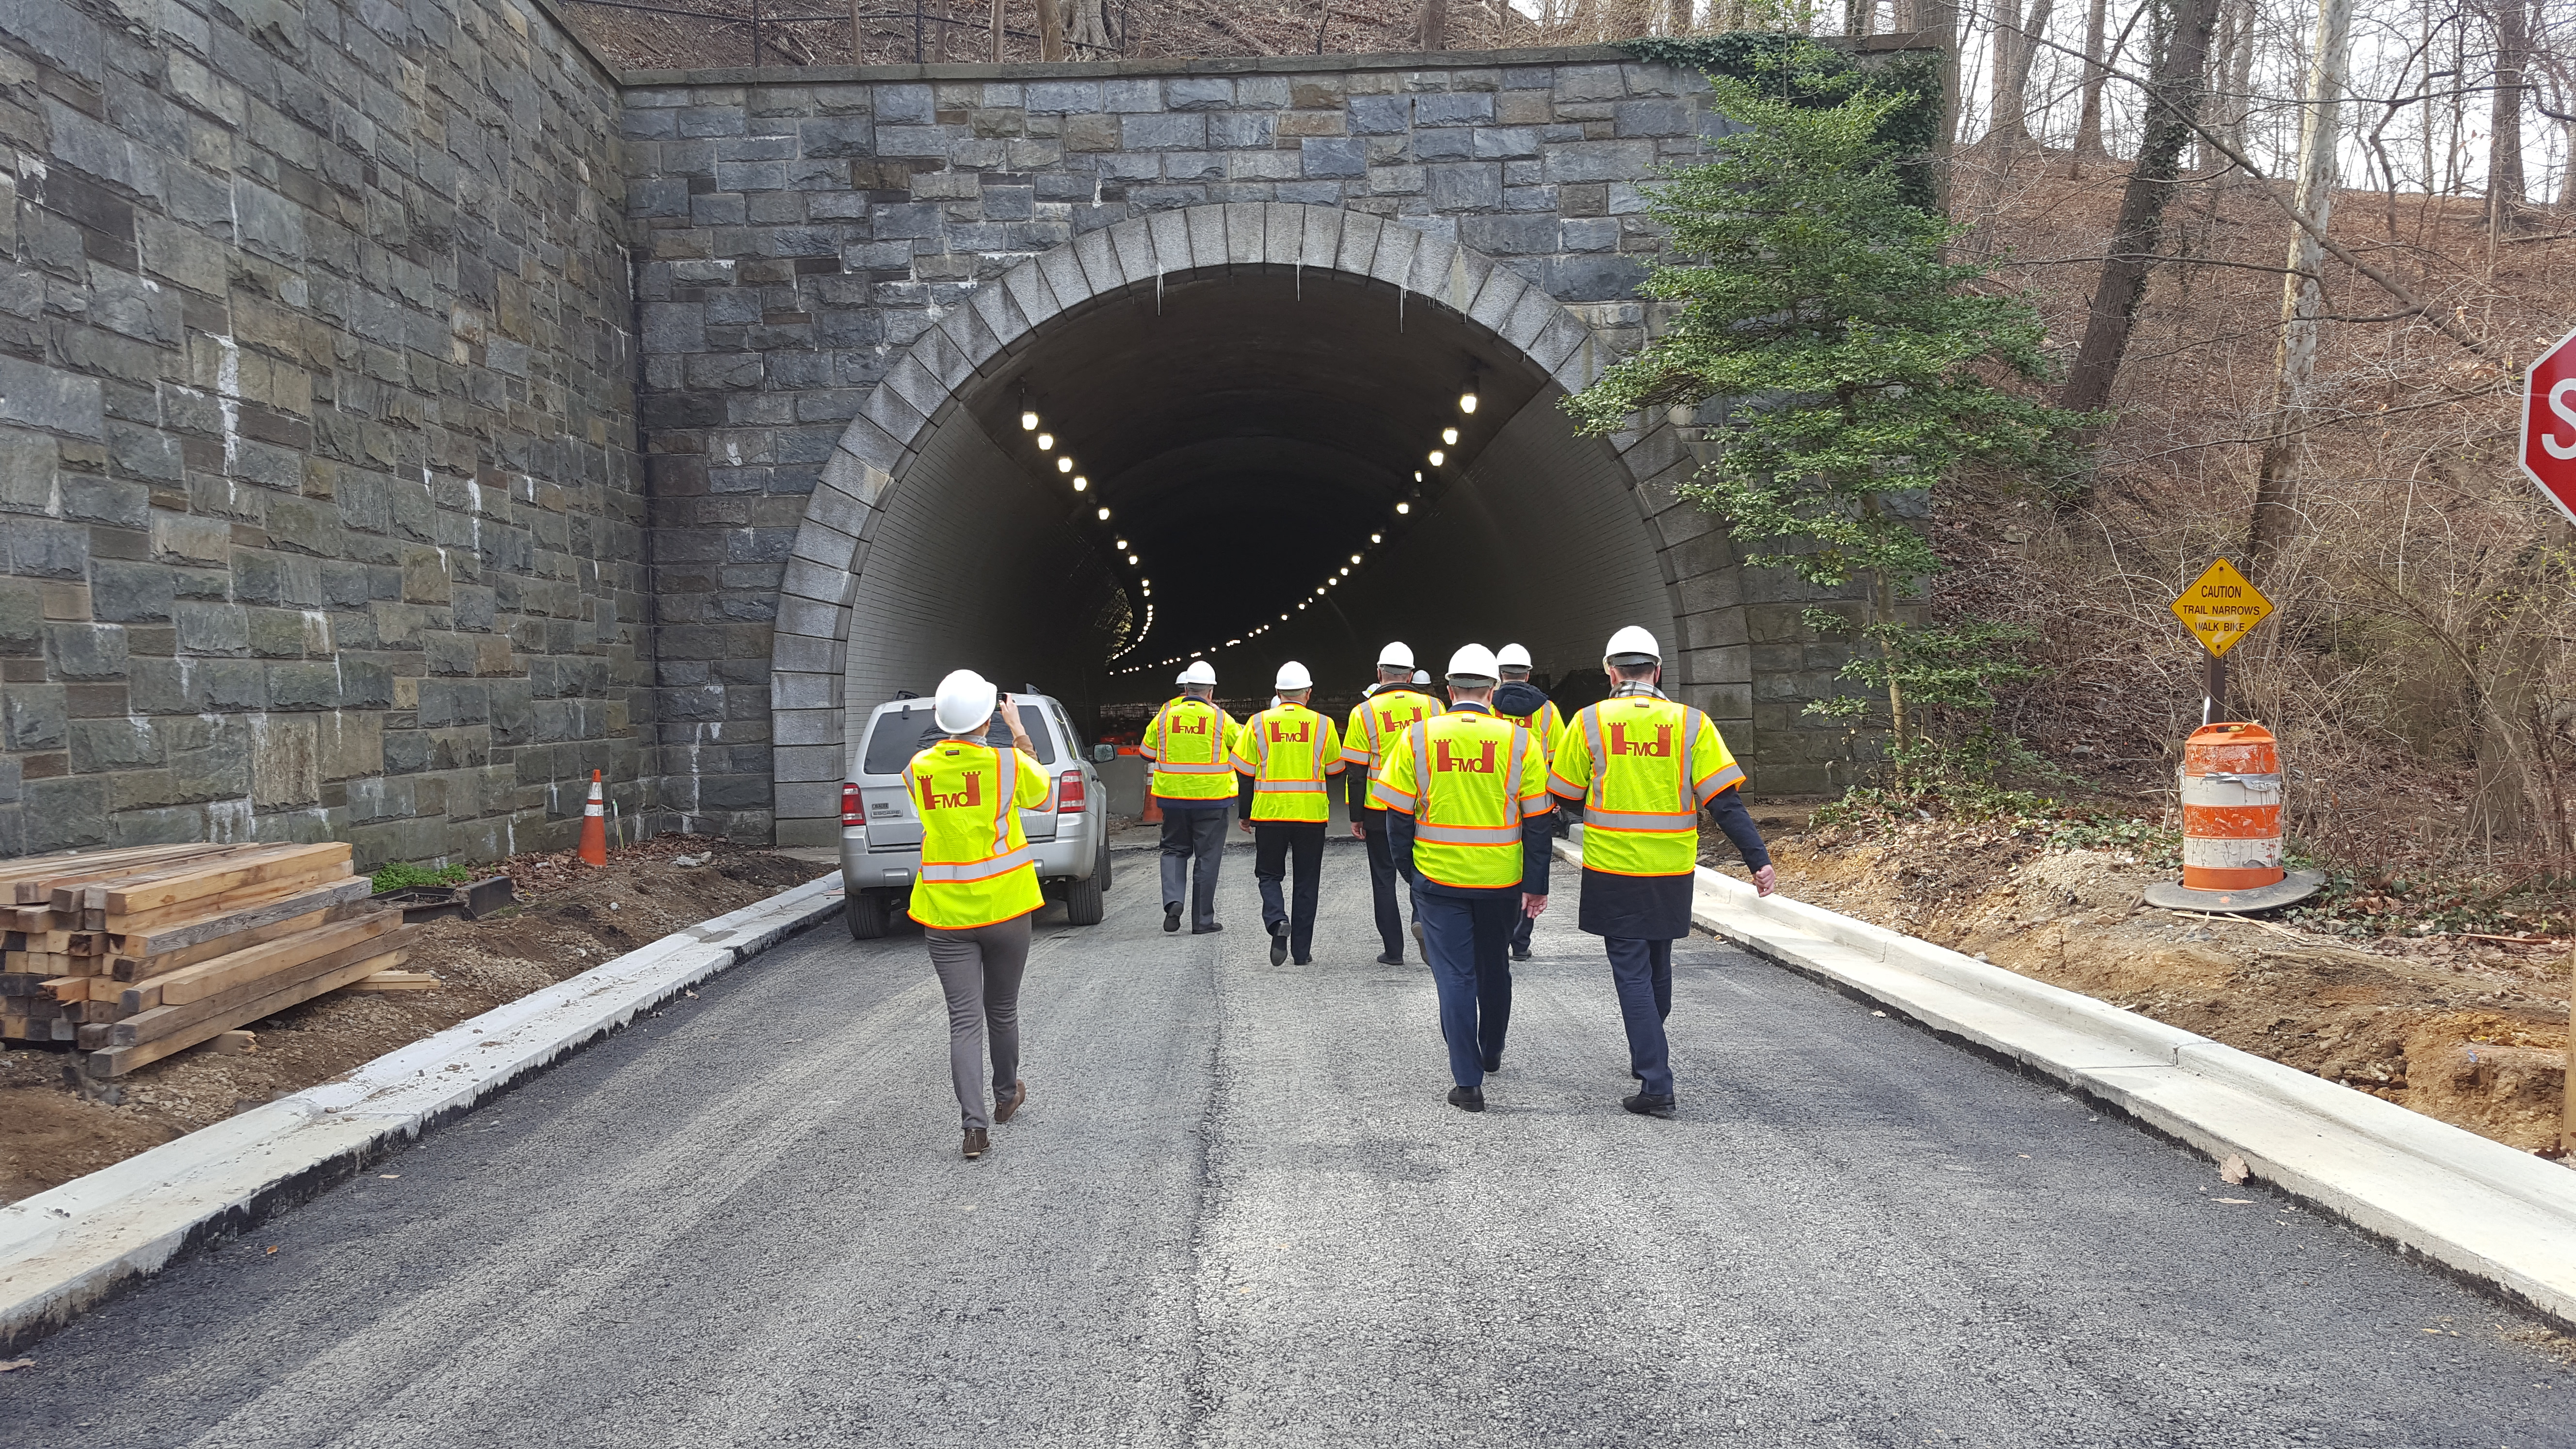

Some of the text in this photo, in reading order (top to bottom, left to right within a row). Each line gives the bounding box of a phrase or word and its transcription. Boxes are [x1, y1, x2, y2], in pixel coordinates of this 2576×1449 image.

[2202, 585, 2241, 598] CAUTION
[2183, 605, 2260, 615] TRAIL NARROWS
[2195, 622, 2245, 632] WALK BIKE
